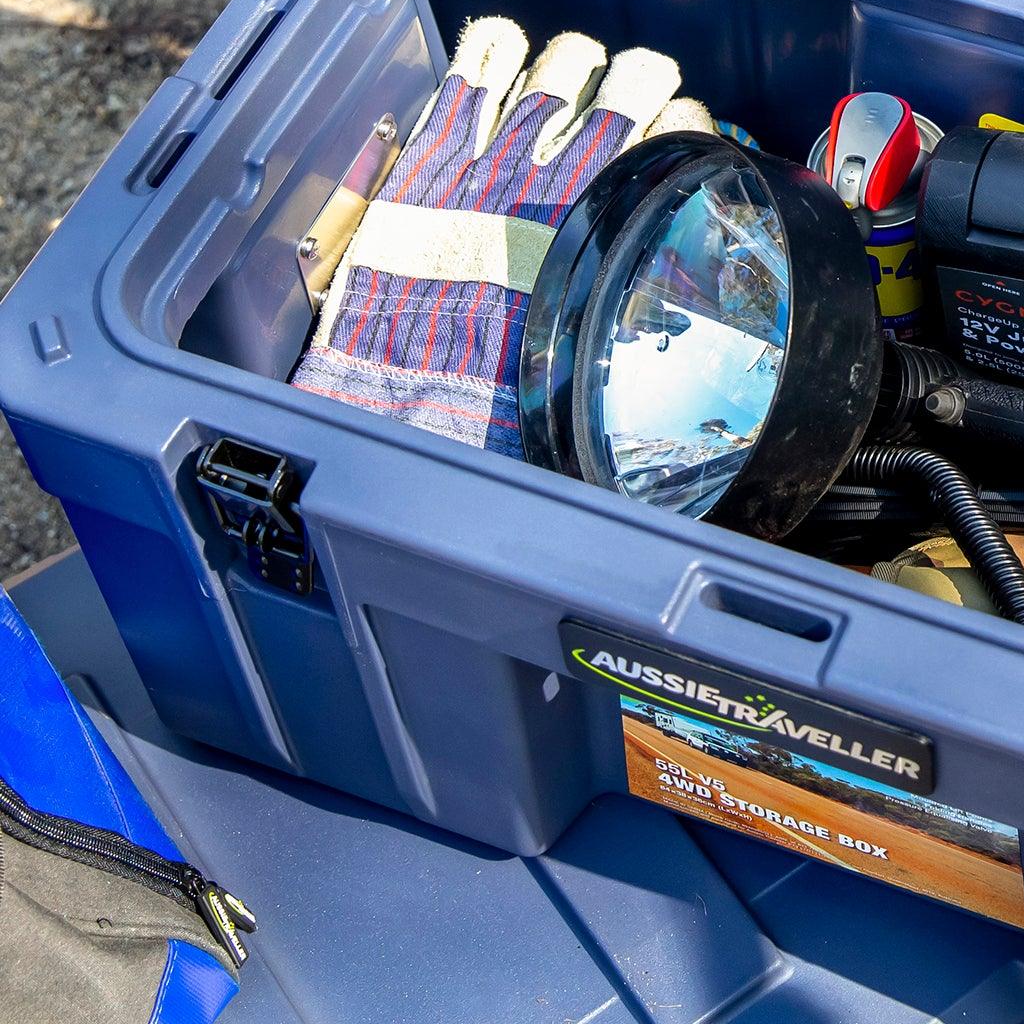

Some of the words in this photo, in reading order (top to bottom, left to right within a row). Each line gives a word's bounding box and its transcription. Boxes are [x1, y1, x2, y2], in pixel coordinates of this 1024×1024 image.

[981, 281, 1002, 291] OPEN
[1002, 287, 1021, 296] HERE
[957, 306, 1020, 329] ChargeUp
[959, 317, 1000, 335] 12V
[962, 328, 979, 340] &
[655, 757, 694, 781] 55L
[698, 772, 727, 792] V5
[658, 773, 712, 799] 4WD
[719, 791, 831, 841] STORAGE
[837, 833, 889, 860] BOX
[885, 795, 923, 812] Pressure
[969, 822, 993, 834] Valve
